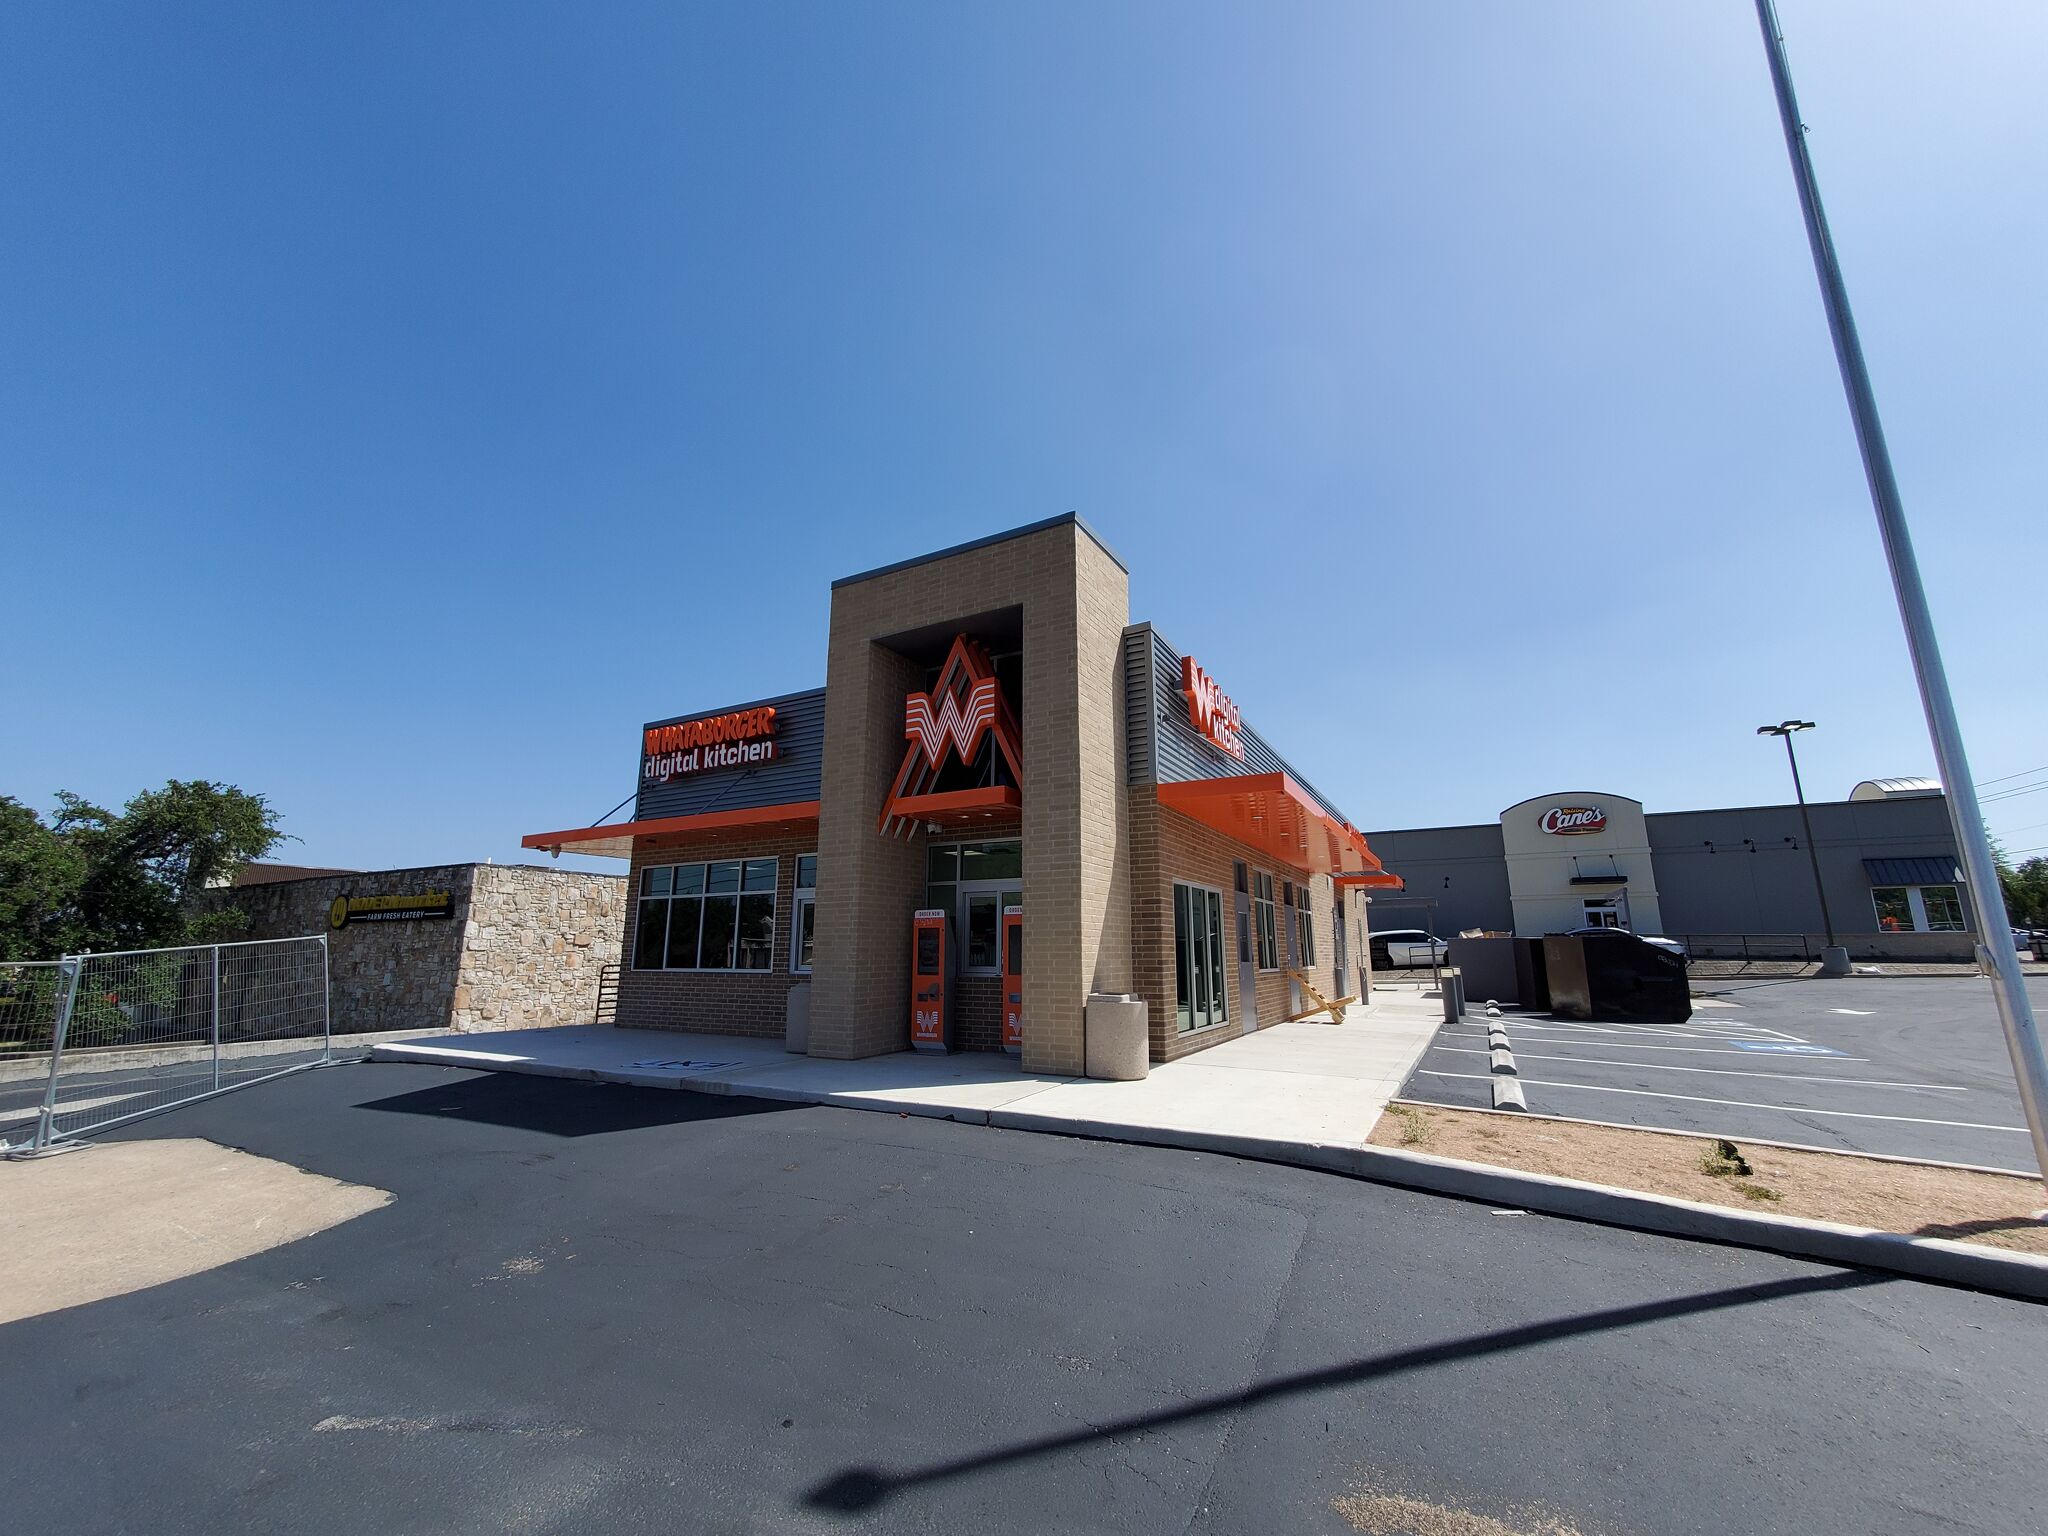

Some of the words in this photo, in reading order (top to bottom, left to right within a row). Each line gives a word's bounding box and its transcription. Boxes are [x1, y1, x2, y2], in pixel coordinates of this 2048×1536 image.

[1214, 685, 1241, 731] digital
[645, 707, 776, 755] WHATABURGER
[1213, 714, 1245, 761] kitchen
[645, 748, 699, 782] digital
[704, 740, 772, 769] kitchen
[1541, 806, 1605, 834] Cane's
[382, 912, 400, 920] FRESH
[401, 910, 425, 919] EATERY
